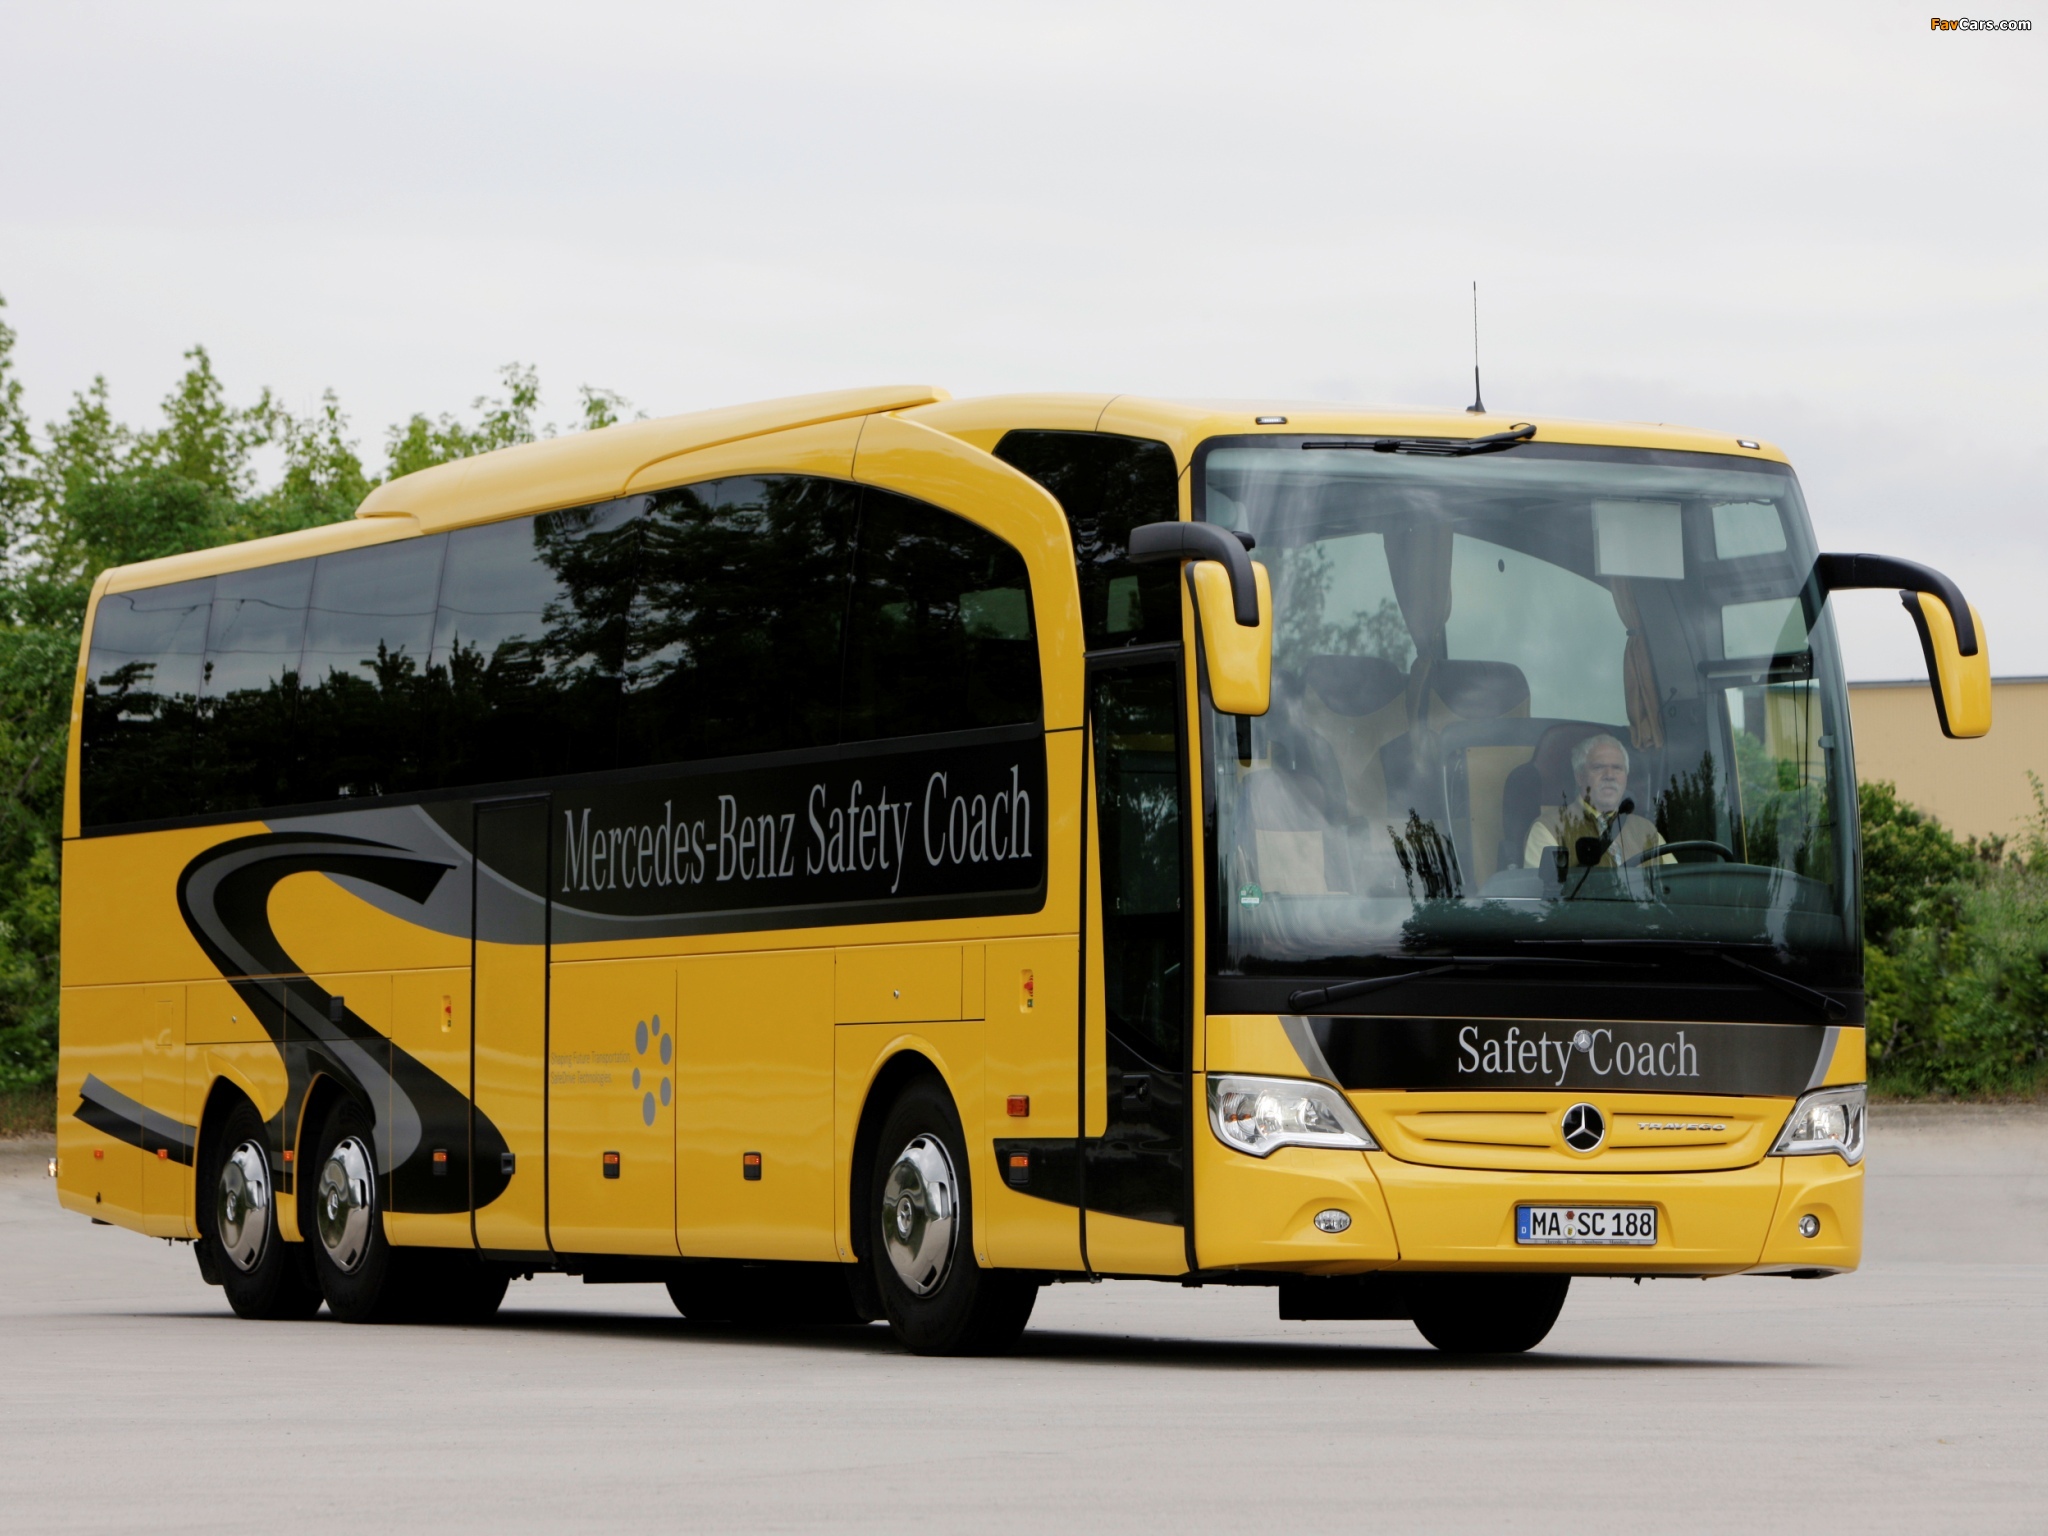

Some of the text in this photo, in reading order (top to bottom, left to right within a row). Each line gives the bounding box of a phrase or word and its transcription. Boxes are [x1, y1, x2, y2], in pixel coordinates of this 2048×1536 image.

[562, 764, 1033, 894] Mercedes-Benz Safety Coach
[1458, 1026, 1700, 1086] Safety Coach
[1637, 1121, 1727, 1131] TRAVEGO
[1521, 1226, 1527, 1234] D
[1532, 1212, 1653, 1237] MA SC 188
